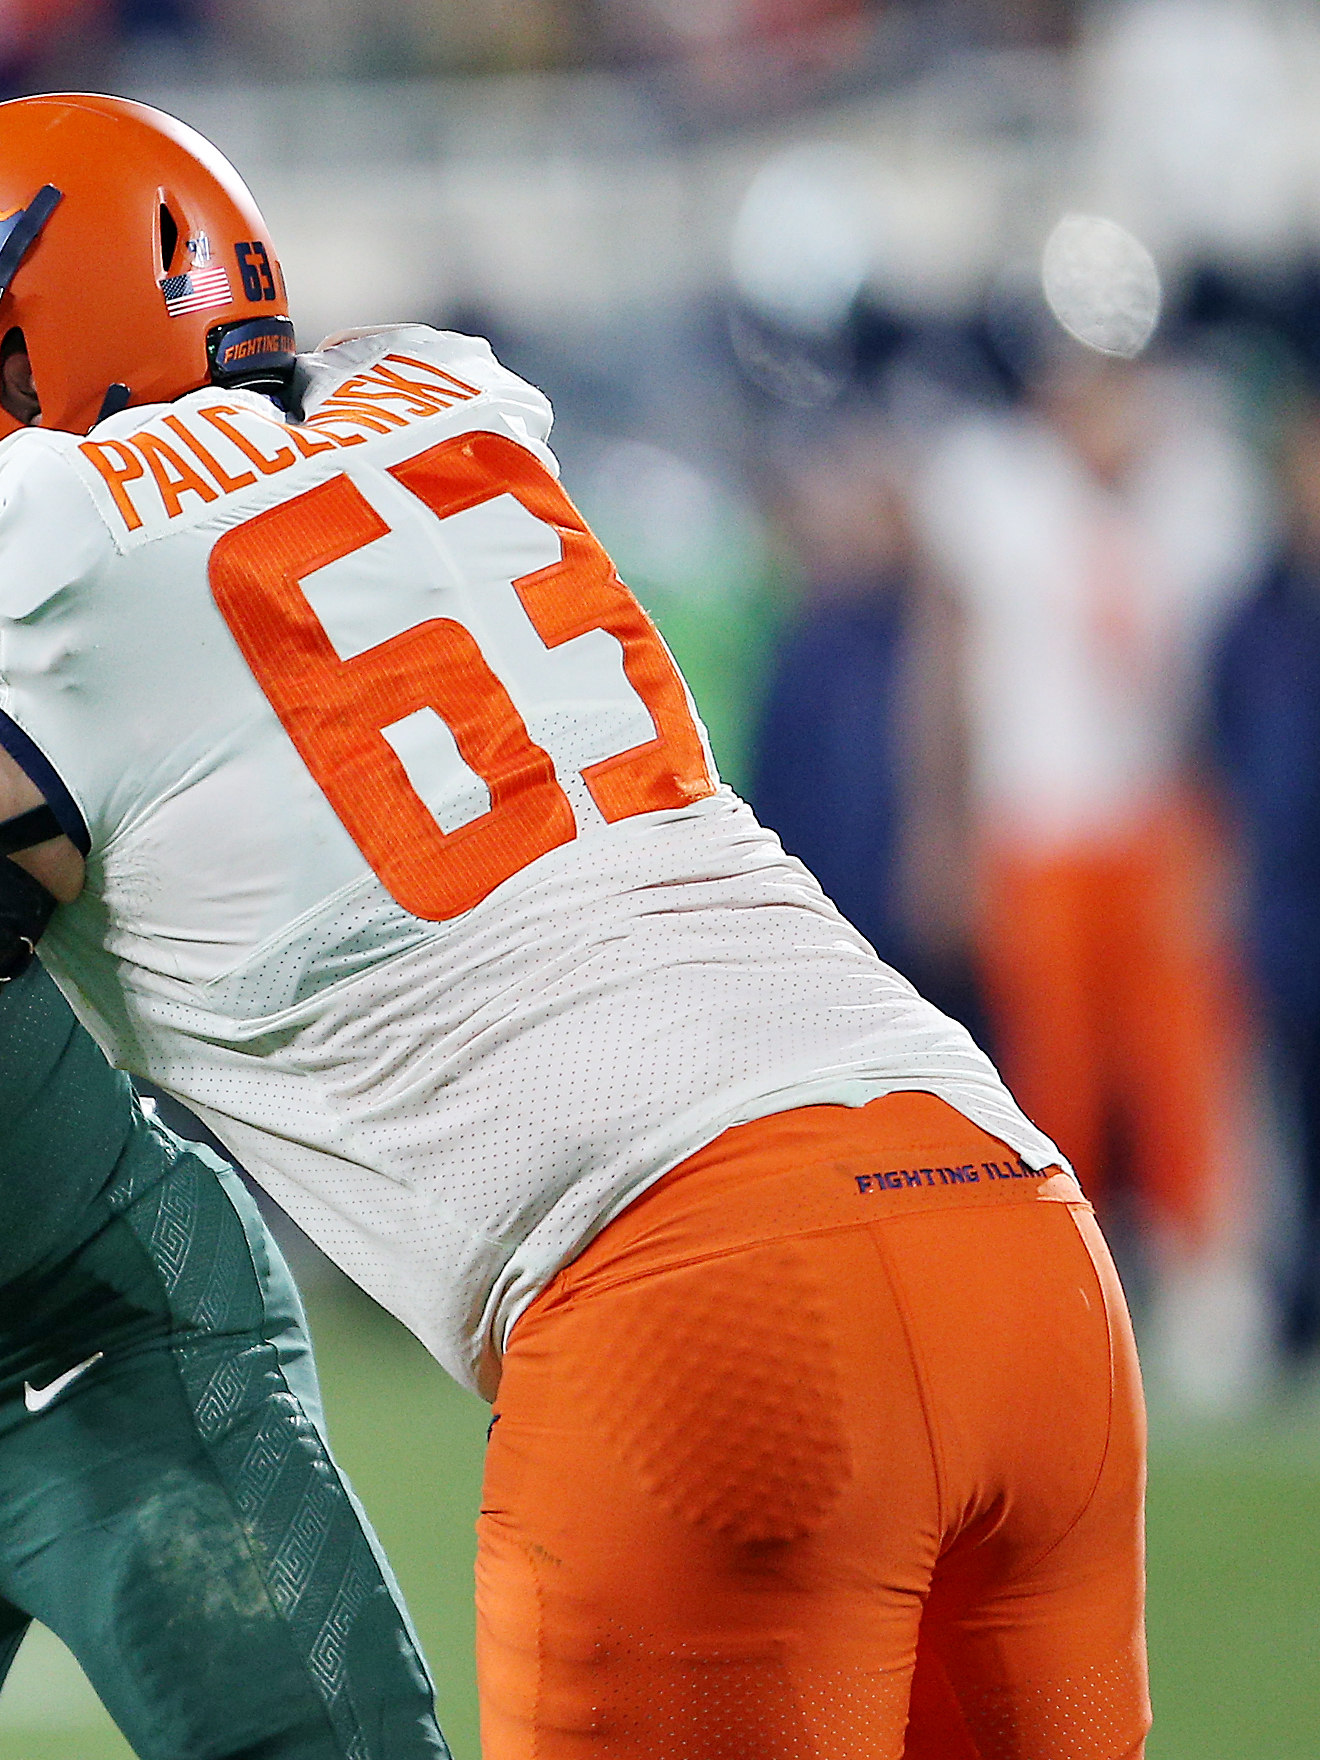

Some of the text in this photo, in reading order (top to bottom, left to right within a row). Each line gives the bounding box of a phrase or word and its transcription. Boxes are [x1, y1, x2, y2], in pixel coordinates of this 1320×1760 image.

[234, 241, 277, 302] 63
[207, 430, 716, 922] 63
[854, 1164, 981, 1194] FIGHTING
